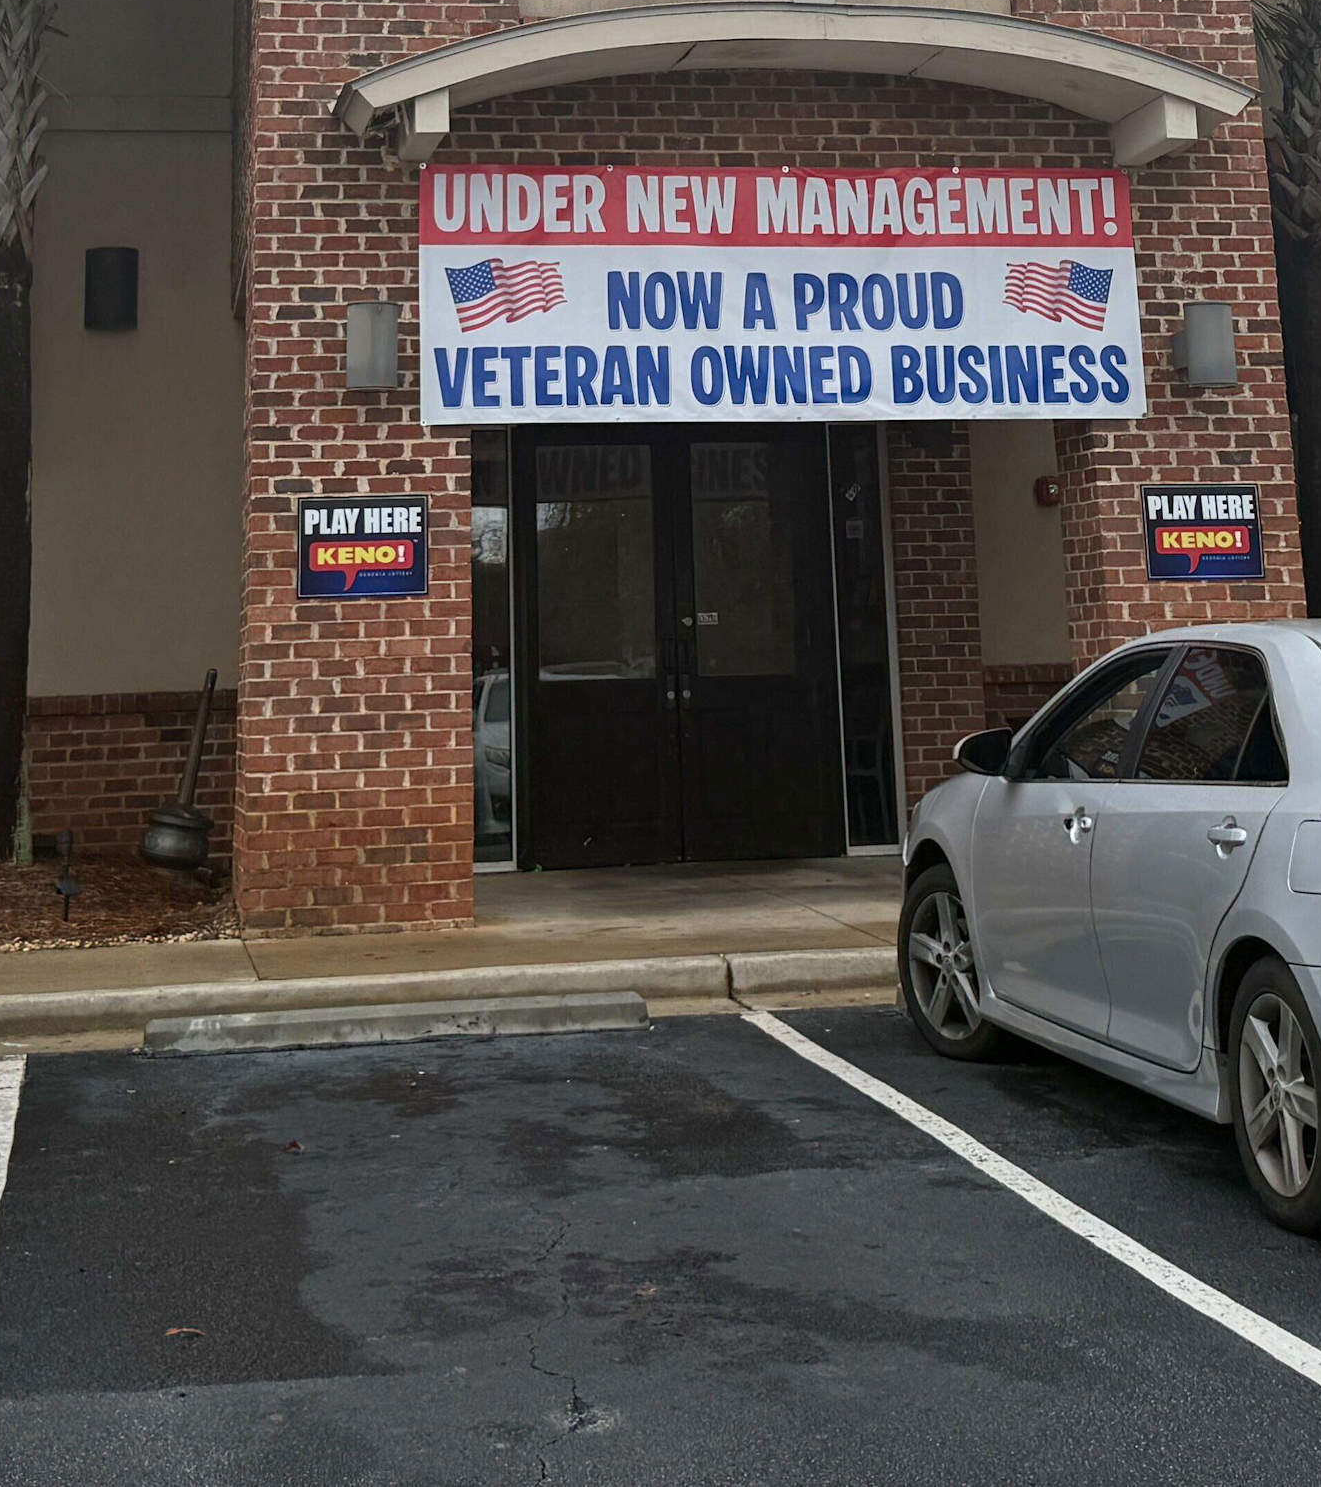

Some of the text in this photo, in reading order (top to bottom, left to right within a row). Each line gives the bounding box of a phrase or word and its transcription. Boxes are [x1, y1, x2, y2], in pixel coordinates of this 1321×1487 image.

[433, 173, 1118, 236] UNDER NEW MANAGEMENT!
[607, 270, 965, 331] NOW A PROUD
[434, 344, 1130, 408] VETERAN OWNED BUSINESS
[304, 506, 422, 535] PLAY HERE
[1147, 494, 1255, 520] PLAY HERE
[317, 544, 406, 565] KENO!
[1162, 531, 1243, 549] KENO!
